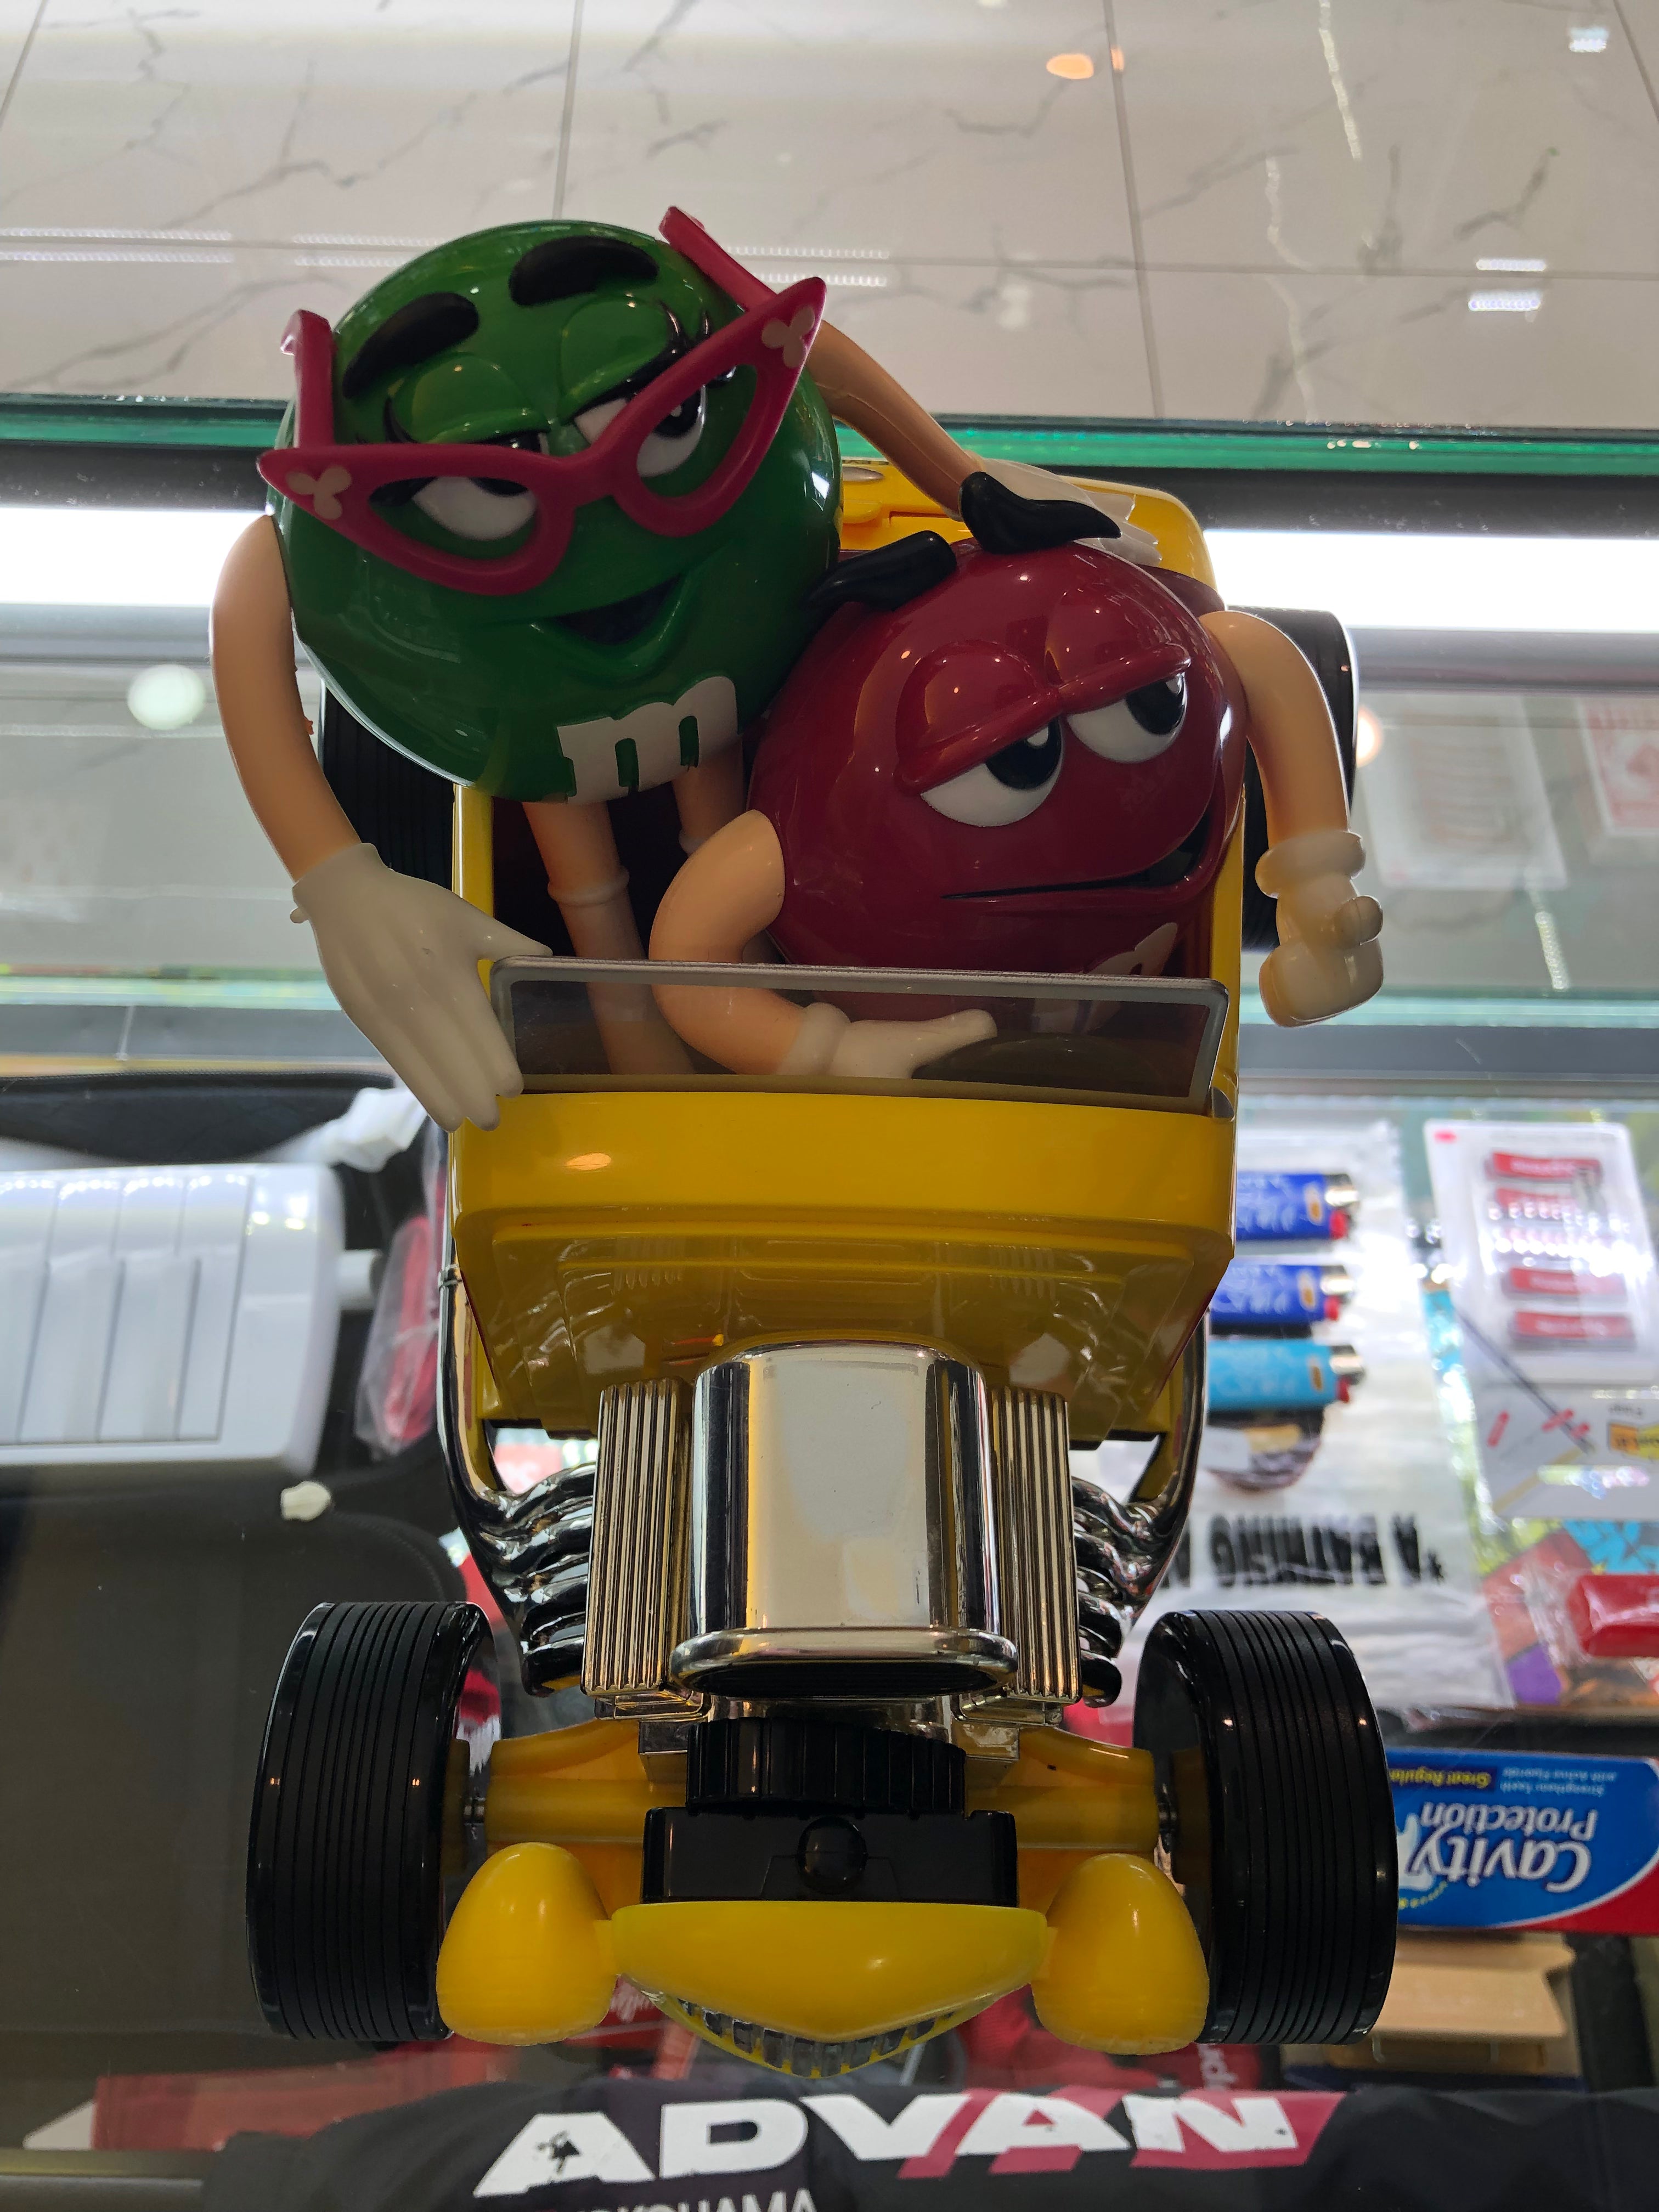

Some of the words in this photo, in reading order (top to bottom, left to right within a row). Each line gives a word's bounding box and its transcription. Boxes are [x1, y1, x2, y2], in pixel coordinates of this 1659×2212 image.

[556, 675, 739, 804] m
[1408, 1824, 1593, 1893] Cavity
[1421, 1802, 1598, 1842] Protection
[472, 2092, 1299, 2197] ADVAN
